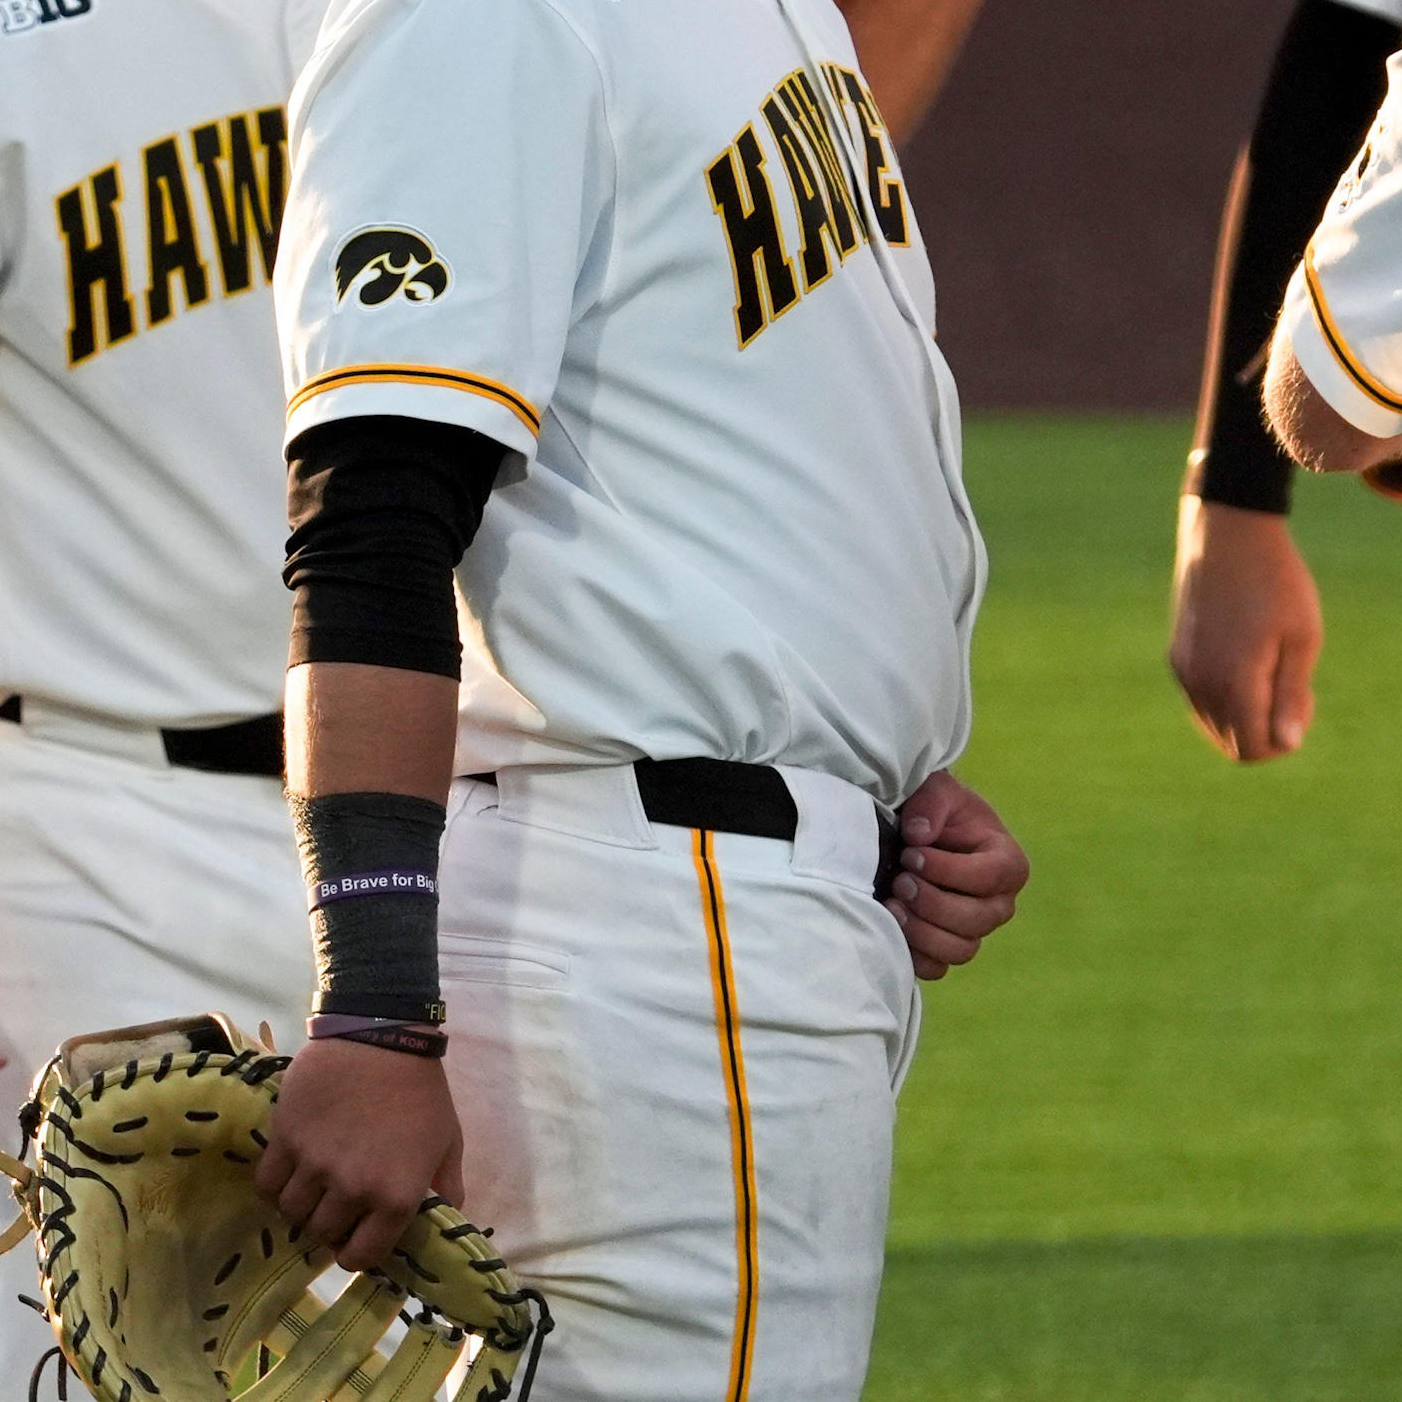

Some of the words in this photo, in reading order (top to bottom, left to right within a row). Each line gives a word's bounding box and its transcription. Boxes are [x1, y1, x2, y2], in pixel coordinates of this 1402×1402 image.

[320, 883, 339, 898] Be
[341, 877, 389, 892] Brave
[391, 873, 414, 887] for
[416, 874, 434, 893] Big
